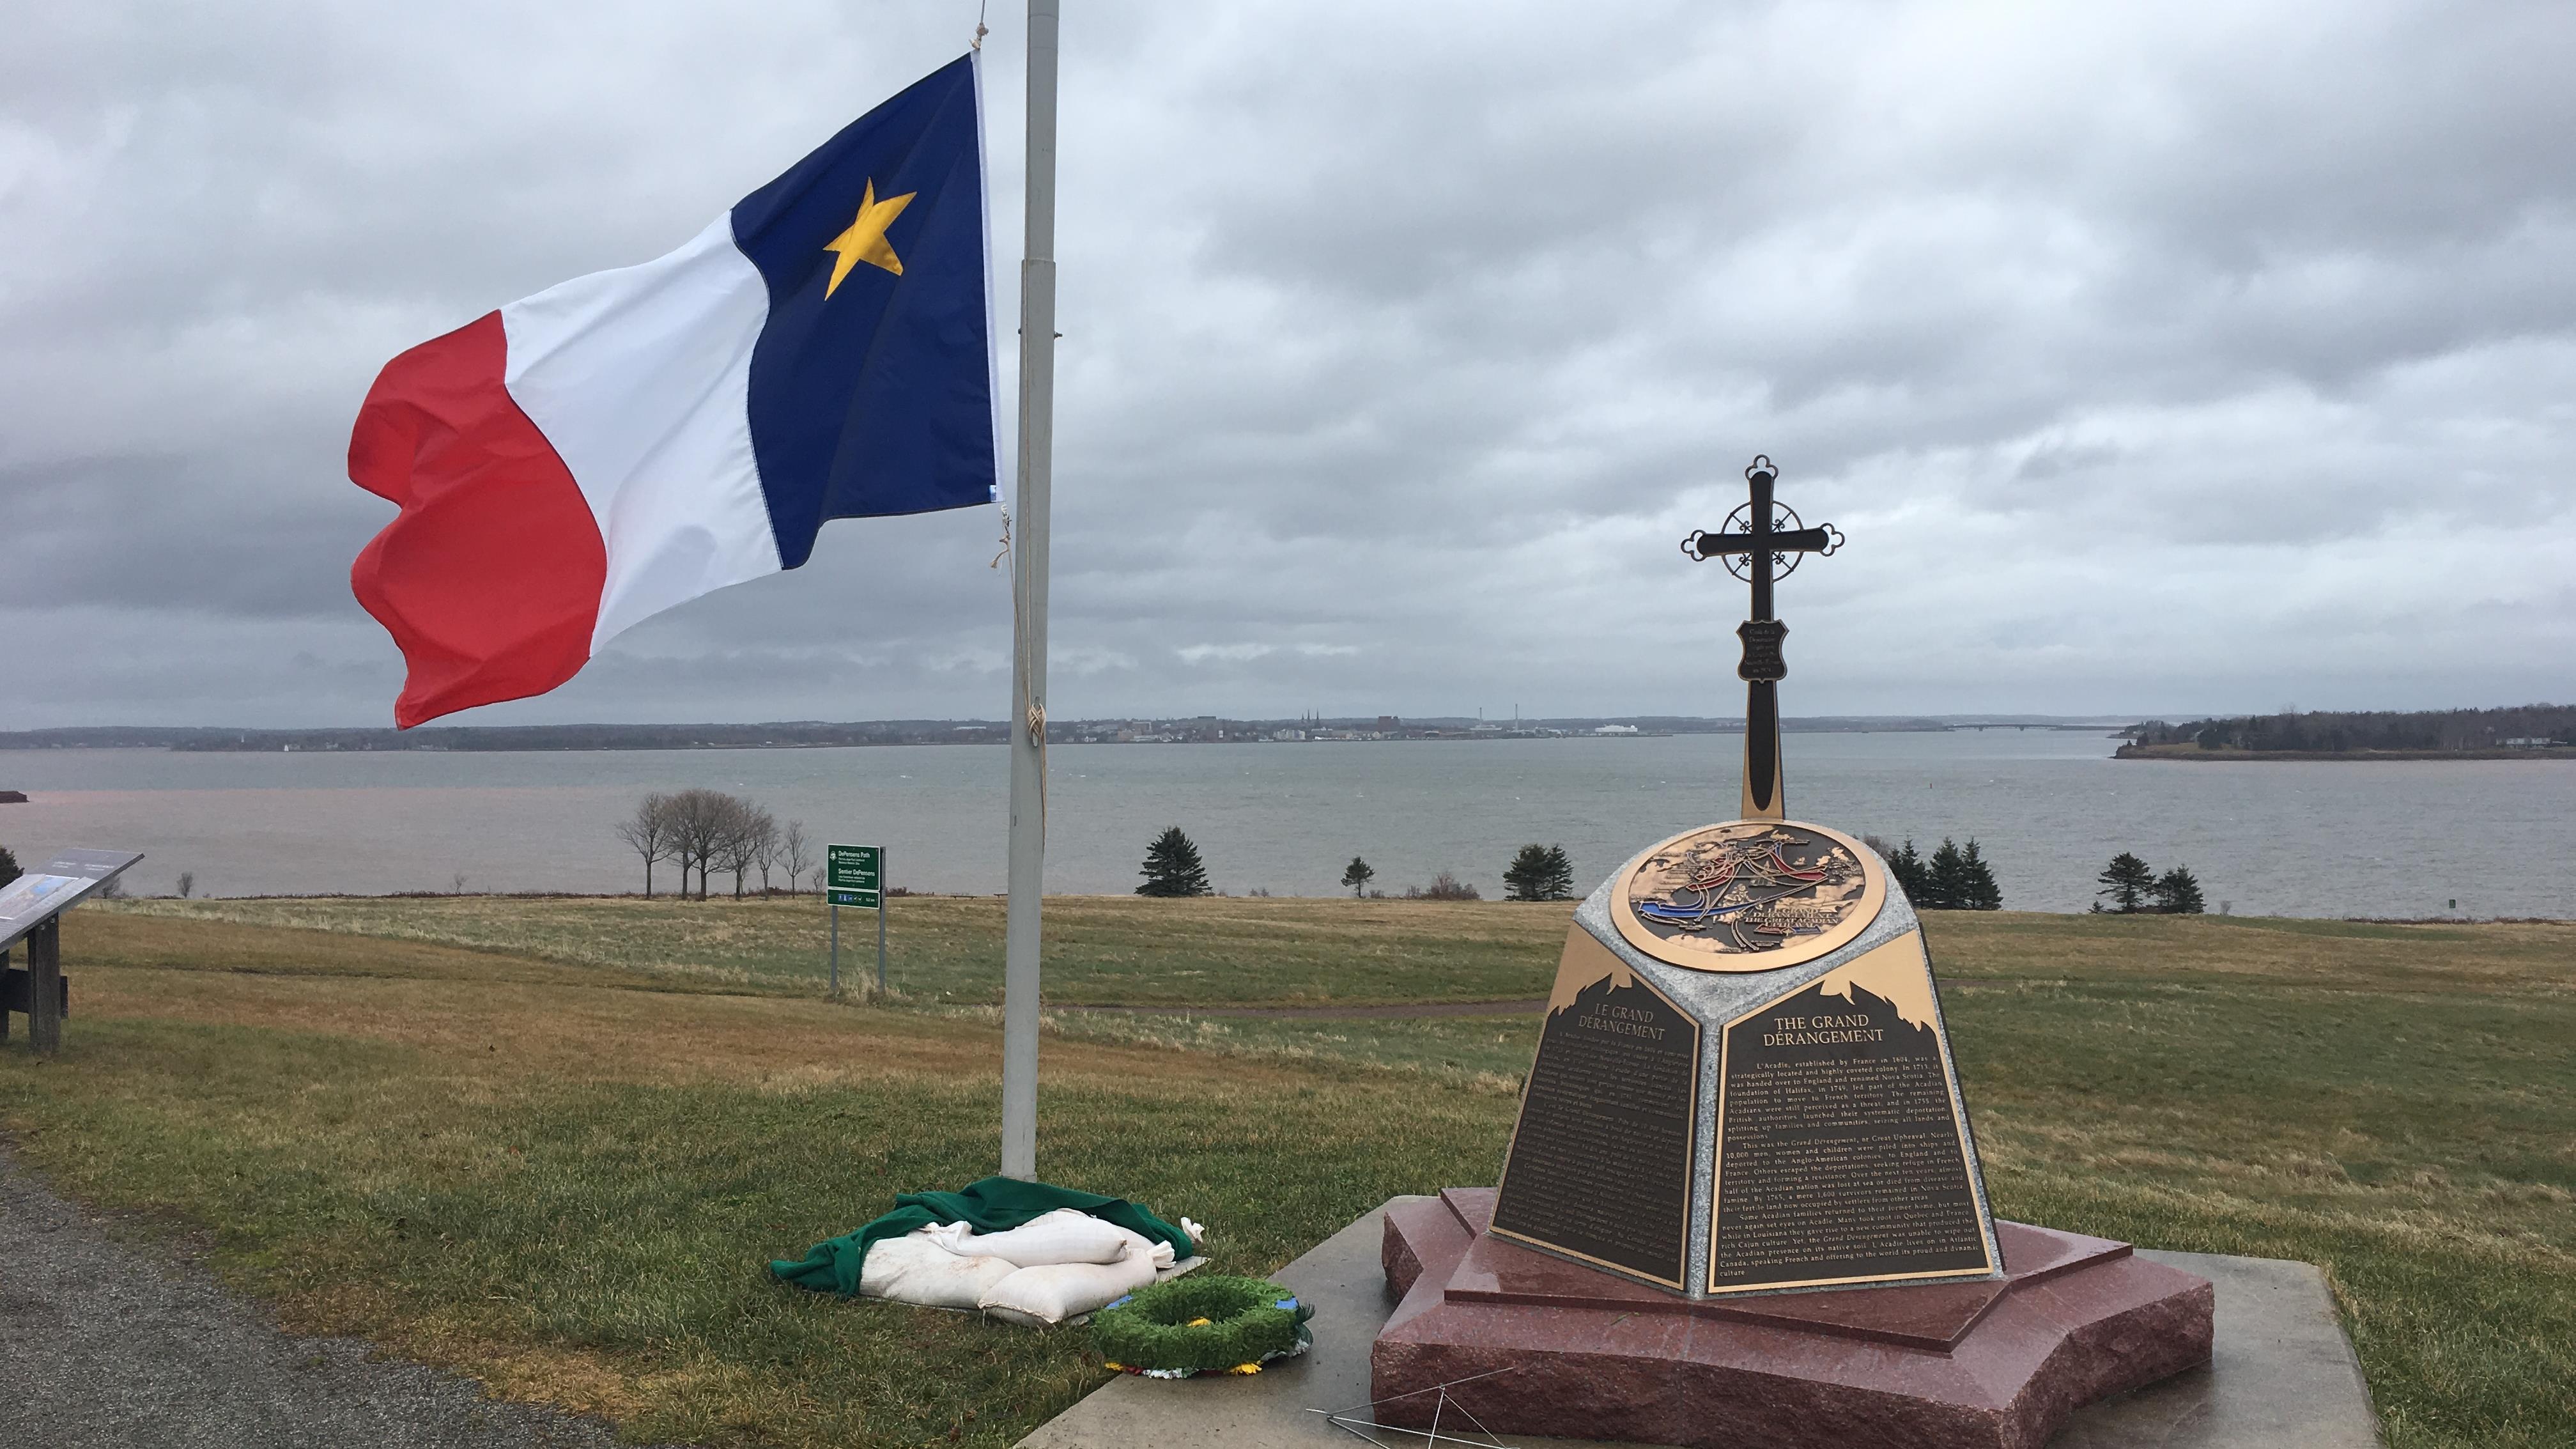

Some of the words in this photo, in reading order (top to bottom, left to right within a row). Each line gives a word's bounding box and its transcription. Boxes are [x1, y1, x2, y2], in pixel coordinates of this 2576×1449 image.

[1594, 1003, 1609, 1016] LE
[1612, 1005, 1654, 1023] GRAND
[1774, 1017, 1807, 1030] THE
[1812, 1014, 1869, 1028] GRAND
[1578, 1014, 1665, 1041] DÉRANGEMENT
[1763, 1029, 1884, 1046] DÉRANGEMENT
[1839, 1058, 1848, 1067] by
[1821, 1067, 1844, 1077] highly
[1803, 1076, 1832, 1086] England
[1729, 1088, 1769, 1097] foundation
[1729, 1097, 1768, 1107] population
[1803, 1111, 1835, 1119] launched
[1863, 1108, 1901, 1118] systematic
[1742, 1141, 1758, 1149] This
[1823, 1145, 1853, 1154] children
[1878, 1143, 1897, 1152] piled
[1725, 1159, 1758, 1170] deported
[1791, 1154, 1848, 1166] Anglo-American
[1899, 1150, 1929, 1159] England
[1753, 1167, 1777, 1175] Others
[1780, 1165, 1808, 1175] escaped
[1765, 1184, 1794, 1193] Acadian
[1796, 1182, 1819, 1191] nation
[1754, 1195, 1762, 1204] By
[1800, 1200, 1832, 1210] occupied
[1833, 1199, 1842, 1208] by
[1762, 1211, 1790, 1220] Acadian
[1858, 1214, 1874, 1223] took
[1752, 1229, 1787, 1238] Louisiana
[1789, 1228, 1804, 1237] they
[1737, 1240, 1759, 1250] Cajun
[1736, 1248, 1765, 1257] Acadian
[1750, 1257, 1782, 1267] speaking
[1784, 1255, 1809, 1263] French
[1911, 1246, 1933, 1257] proud
